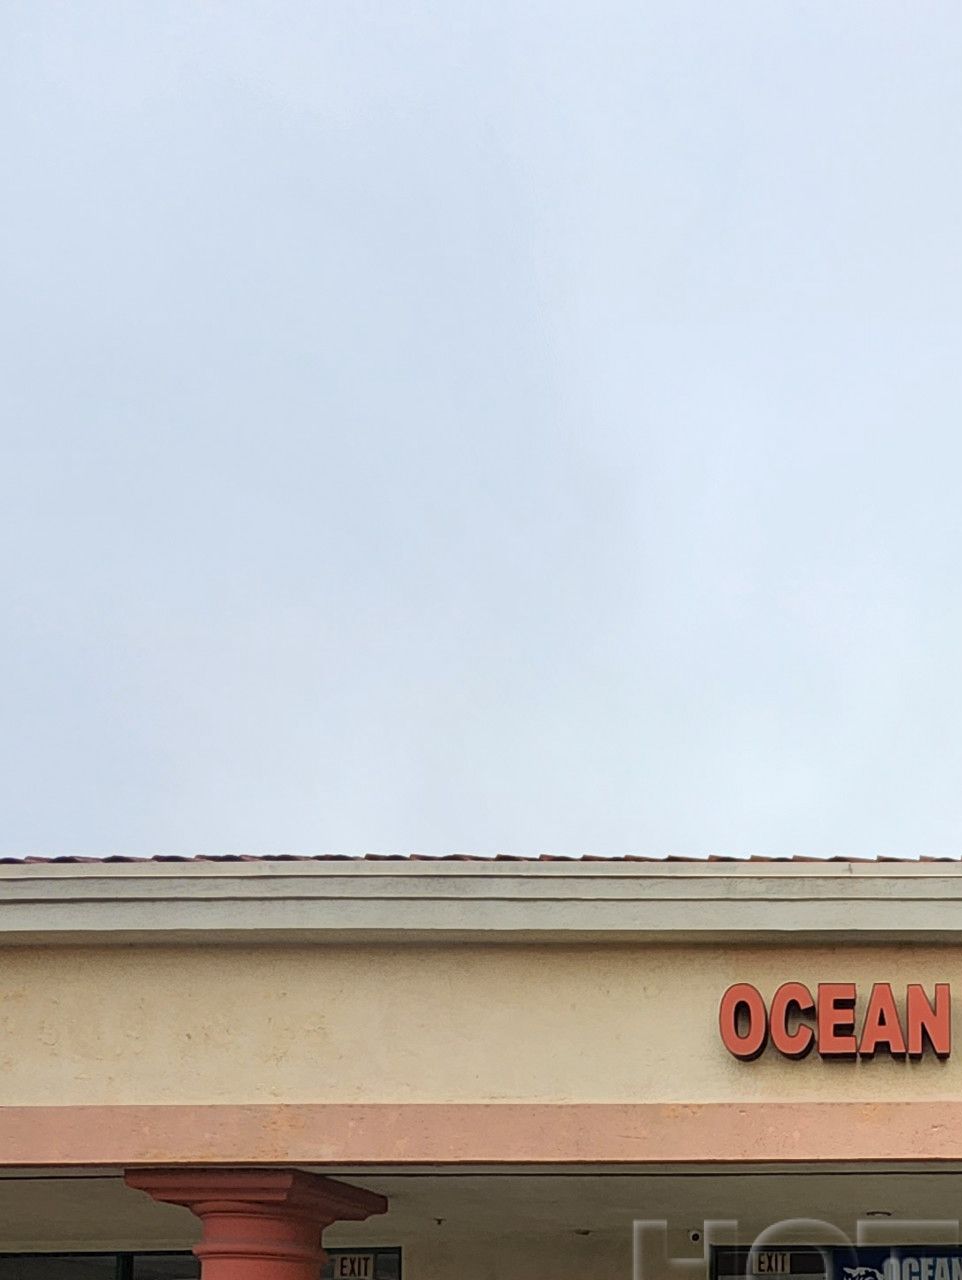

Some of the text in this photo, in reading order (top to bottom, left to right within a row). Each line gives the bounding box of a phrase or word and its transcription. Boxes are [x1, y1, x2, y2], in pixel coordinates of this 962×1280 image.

[719, 981, 951, 1061] OCEAN
[339, 1256, 370, 1277] EXIT
[757, 1252, 788, 1274] EXIT
